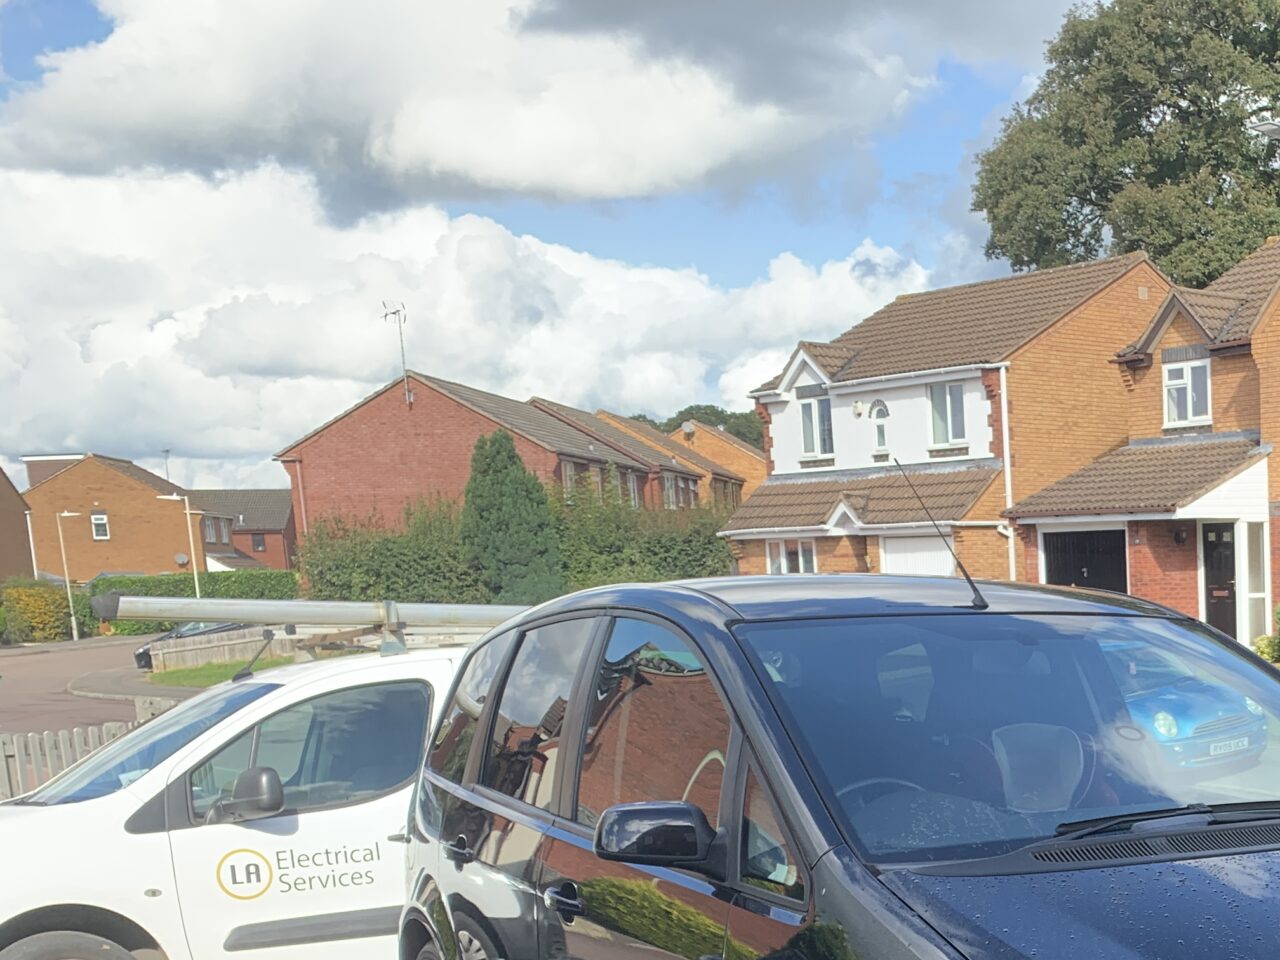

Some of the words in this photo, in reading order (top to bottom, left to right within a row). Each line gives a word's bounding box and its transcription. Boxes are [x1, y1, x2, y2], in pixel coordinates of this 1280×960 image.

[276, 842, 381, 870] Electrical
[230, 863, 261, 885] LA
[279, 870, 375, 893] Services
